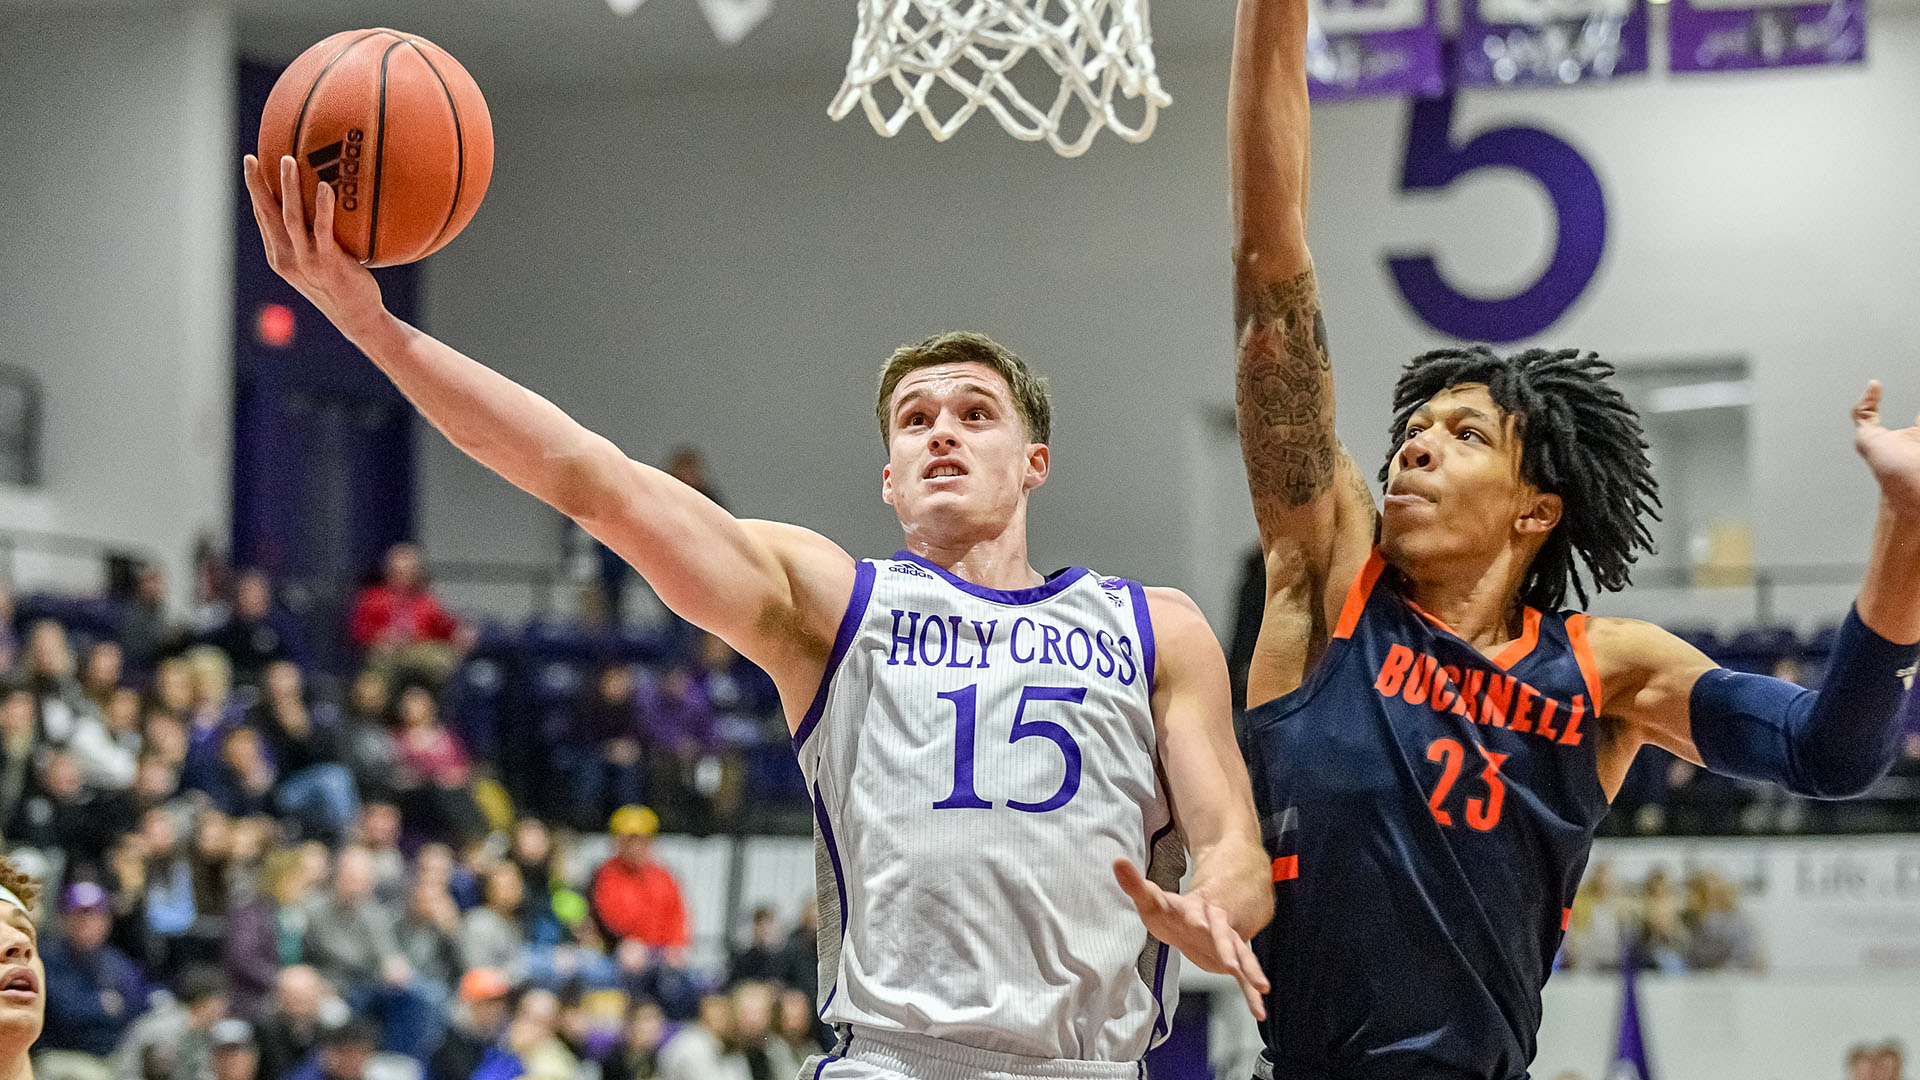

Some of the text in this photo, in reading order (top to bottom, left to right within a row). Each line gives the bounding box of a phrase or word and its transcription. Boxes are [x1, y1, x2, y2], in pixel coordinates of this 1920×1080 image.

[341, 128, 364, 211] adidas
[1386, 46, 1606, 344] 5
[888, 566, 934, 580] adidas
[886, 609, 1137, 687] HOLY CROSS
[1374, 643, 1584, 746] BUCKNELL
[932, 683, 1088, 813] 15
[1427, 738, 1510, 831] 23
